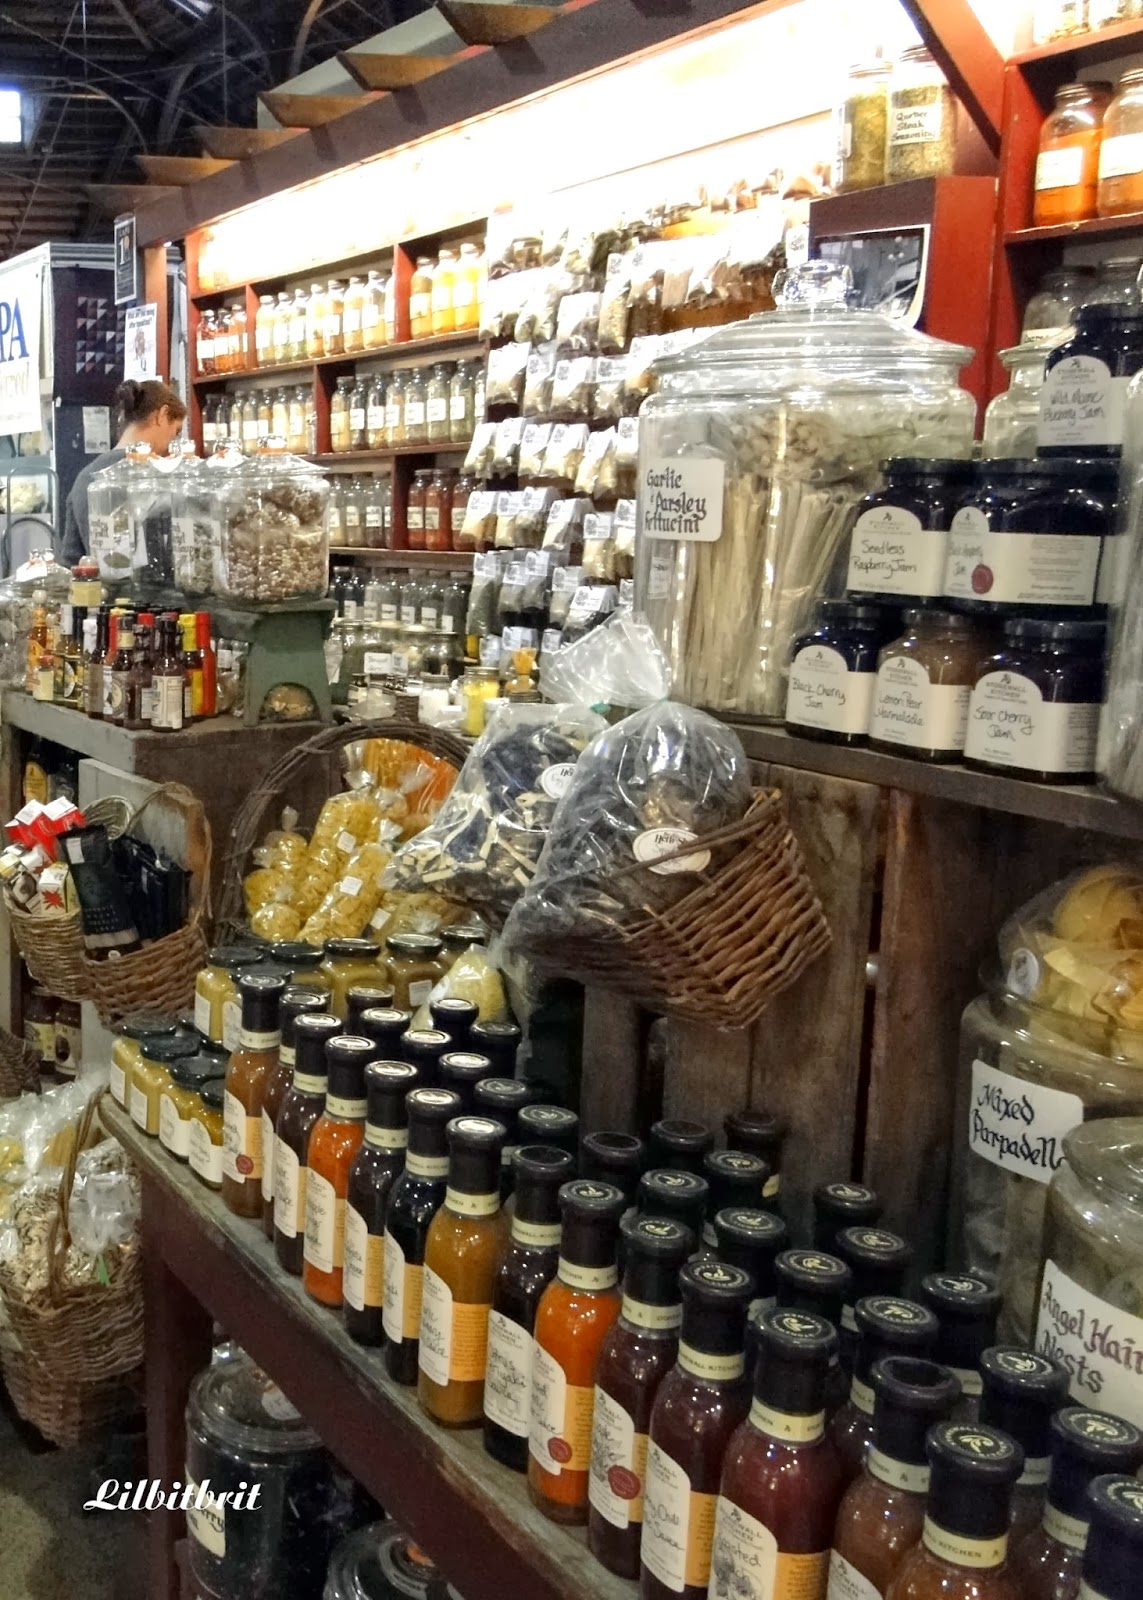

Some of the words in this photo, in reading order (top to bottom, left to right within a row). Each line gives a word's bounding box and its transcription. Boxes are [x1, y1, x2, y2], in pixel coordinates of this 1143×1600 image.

[646, 467, 682, 489] Garlic
[650, 491, 706, 520] Parsley
[862, 539, 905, 555] Seedless
[977, 1084, 1035, 1126] Mixed
[970, 1108, 1067, 1171] Parpadell
[1042, 1281, 1086, 1340] Angel
